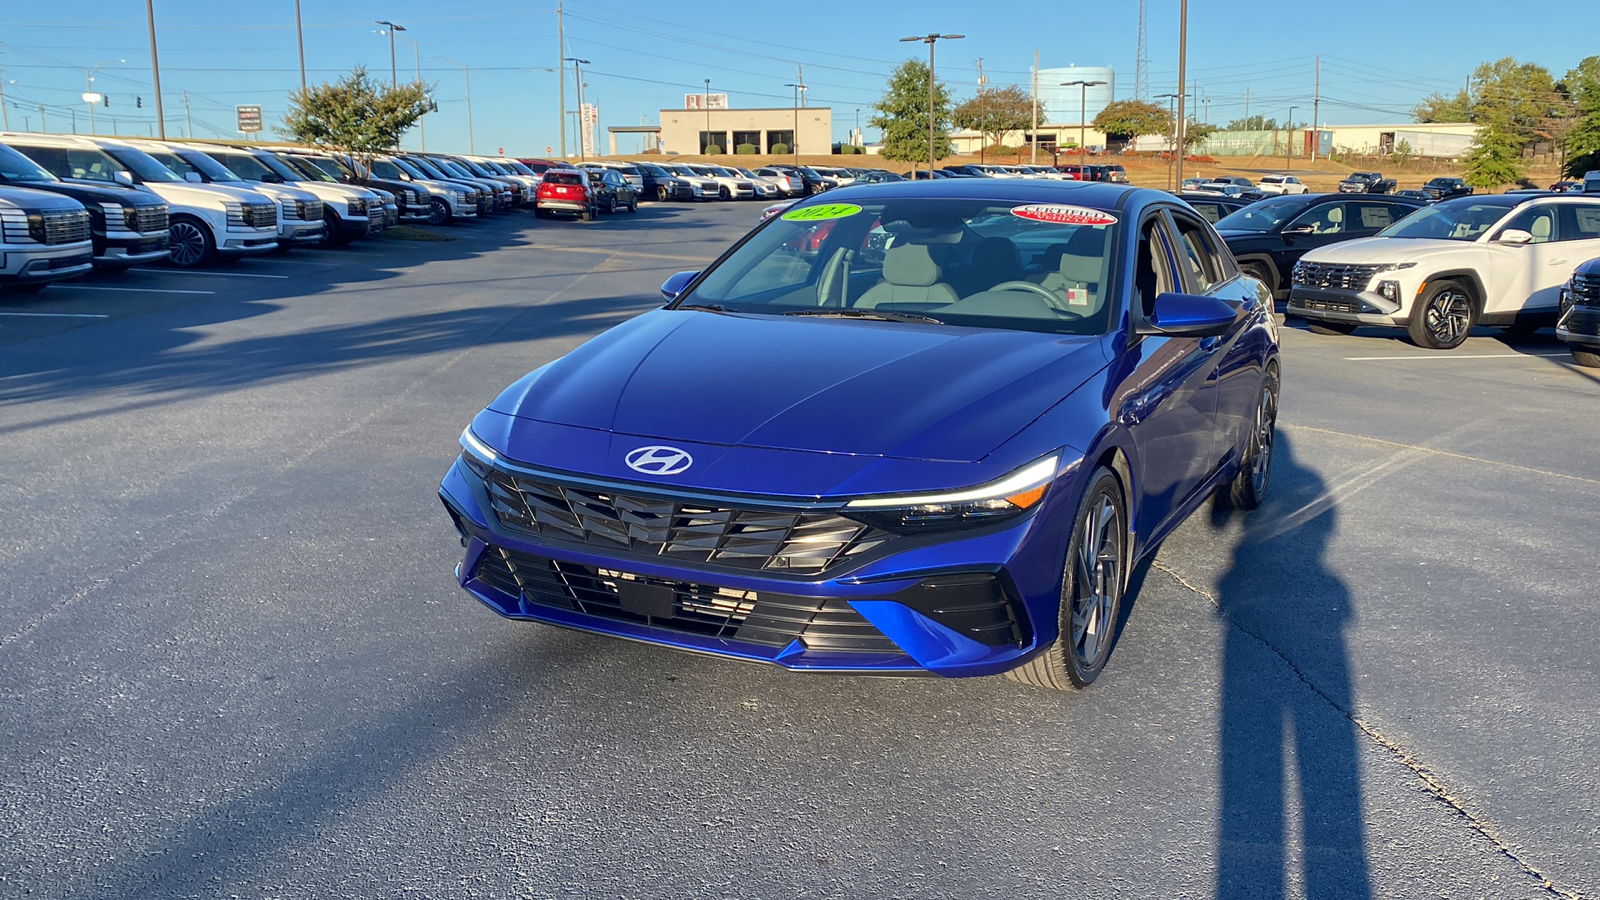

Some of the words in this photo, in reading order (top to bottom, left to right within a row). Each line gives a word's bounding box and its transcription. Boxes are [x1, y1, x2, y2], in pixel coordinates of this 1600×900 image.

[790, 206, 852, 218] 2024
[1024, 206, 1106, 218] CERTIFIED
[1037, 215, 1090, 223] VEHICLE
